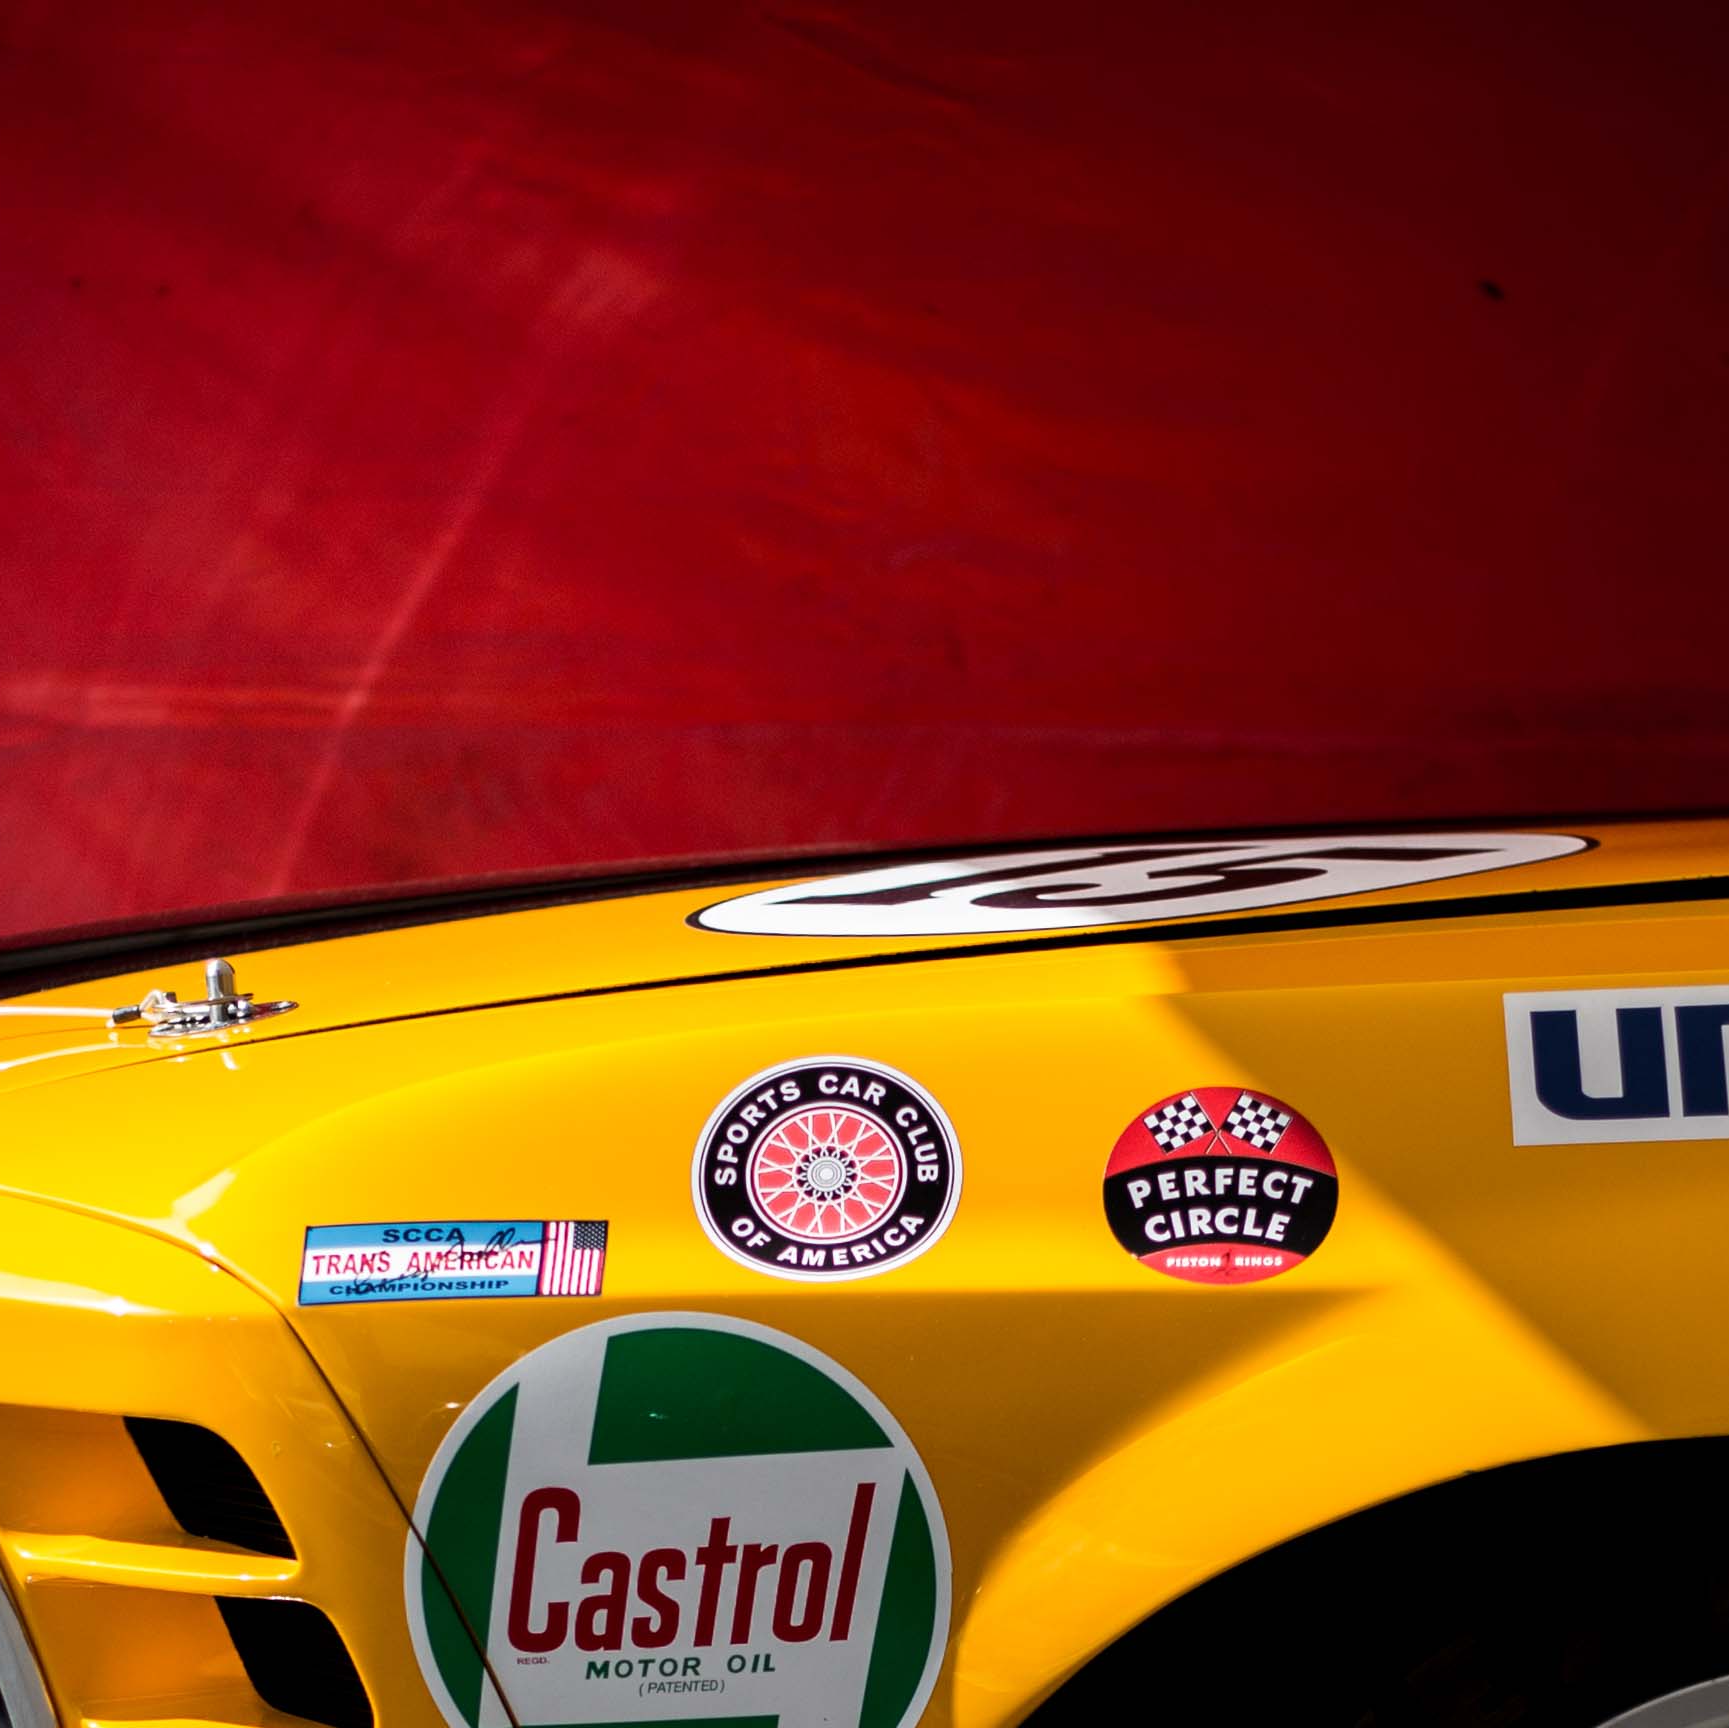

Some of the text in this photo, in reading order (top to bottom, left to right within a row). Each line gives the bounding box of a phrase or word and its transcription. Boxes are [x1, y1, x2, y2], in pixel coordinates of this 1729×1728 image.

[768, 846, 1504, 910] 15
[714, 1073, 940, 1186] SPORTS CAR CLUB
[1126, 1167, 1314, 1209] PERFECT
[382, 1227, 466, 1243] SCCA
[731, 1214, 925, 1266] OF AMERICA
[1144, 1207, 1291, 1243] CIRCLE
[312, 1249, 534, 1276] TRANS AMERICAN
[1166, 1256, 1283, 1268] PISTON RINGS
[329, 1280, 509, 1296] CHAMPIONSHIP
[507, 1482, 876, 1653] Castrol
[585, 1653, 776, 1680] MOTOR OIL
